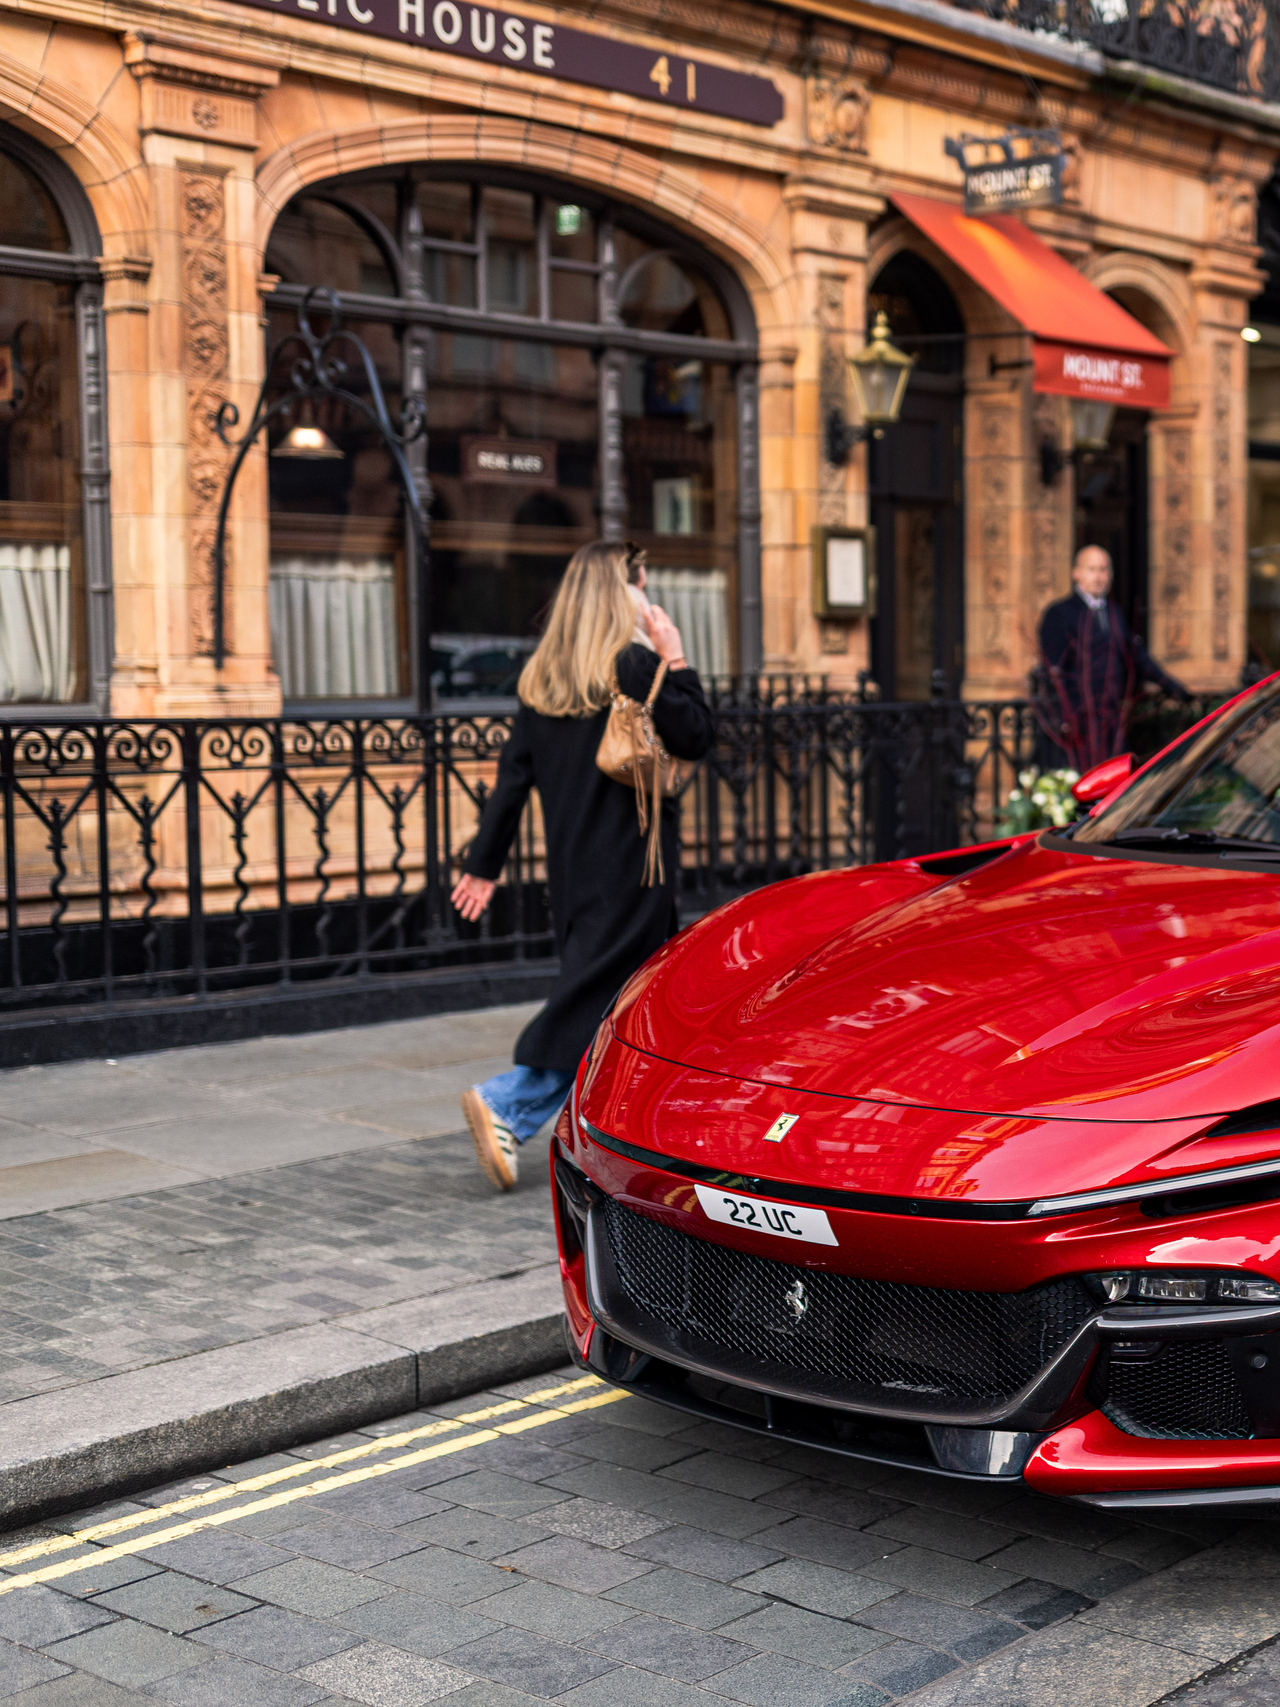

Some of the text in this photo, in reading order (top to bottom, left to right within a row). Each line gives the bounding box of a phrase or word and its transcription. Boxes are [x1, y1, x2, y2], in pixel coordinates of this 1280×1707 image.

[398, 0, 555, 69] HOUSE
[966, 168, 1028, 195] MOUNT
[1063, 353, 1120, 383] MOUNT
[723, 1198, 802, 1235] 22 UC
